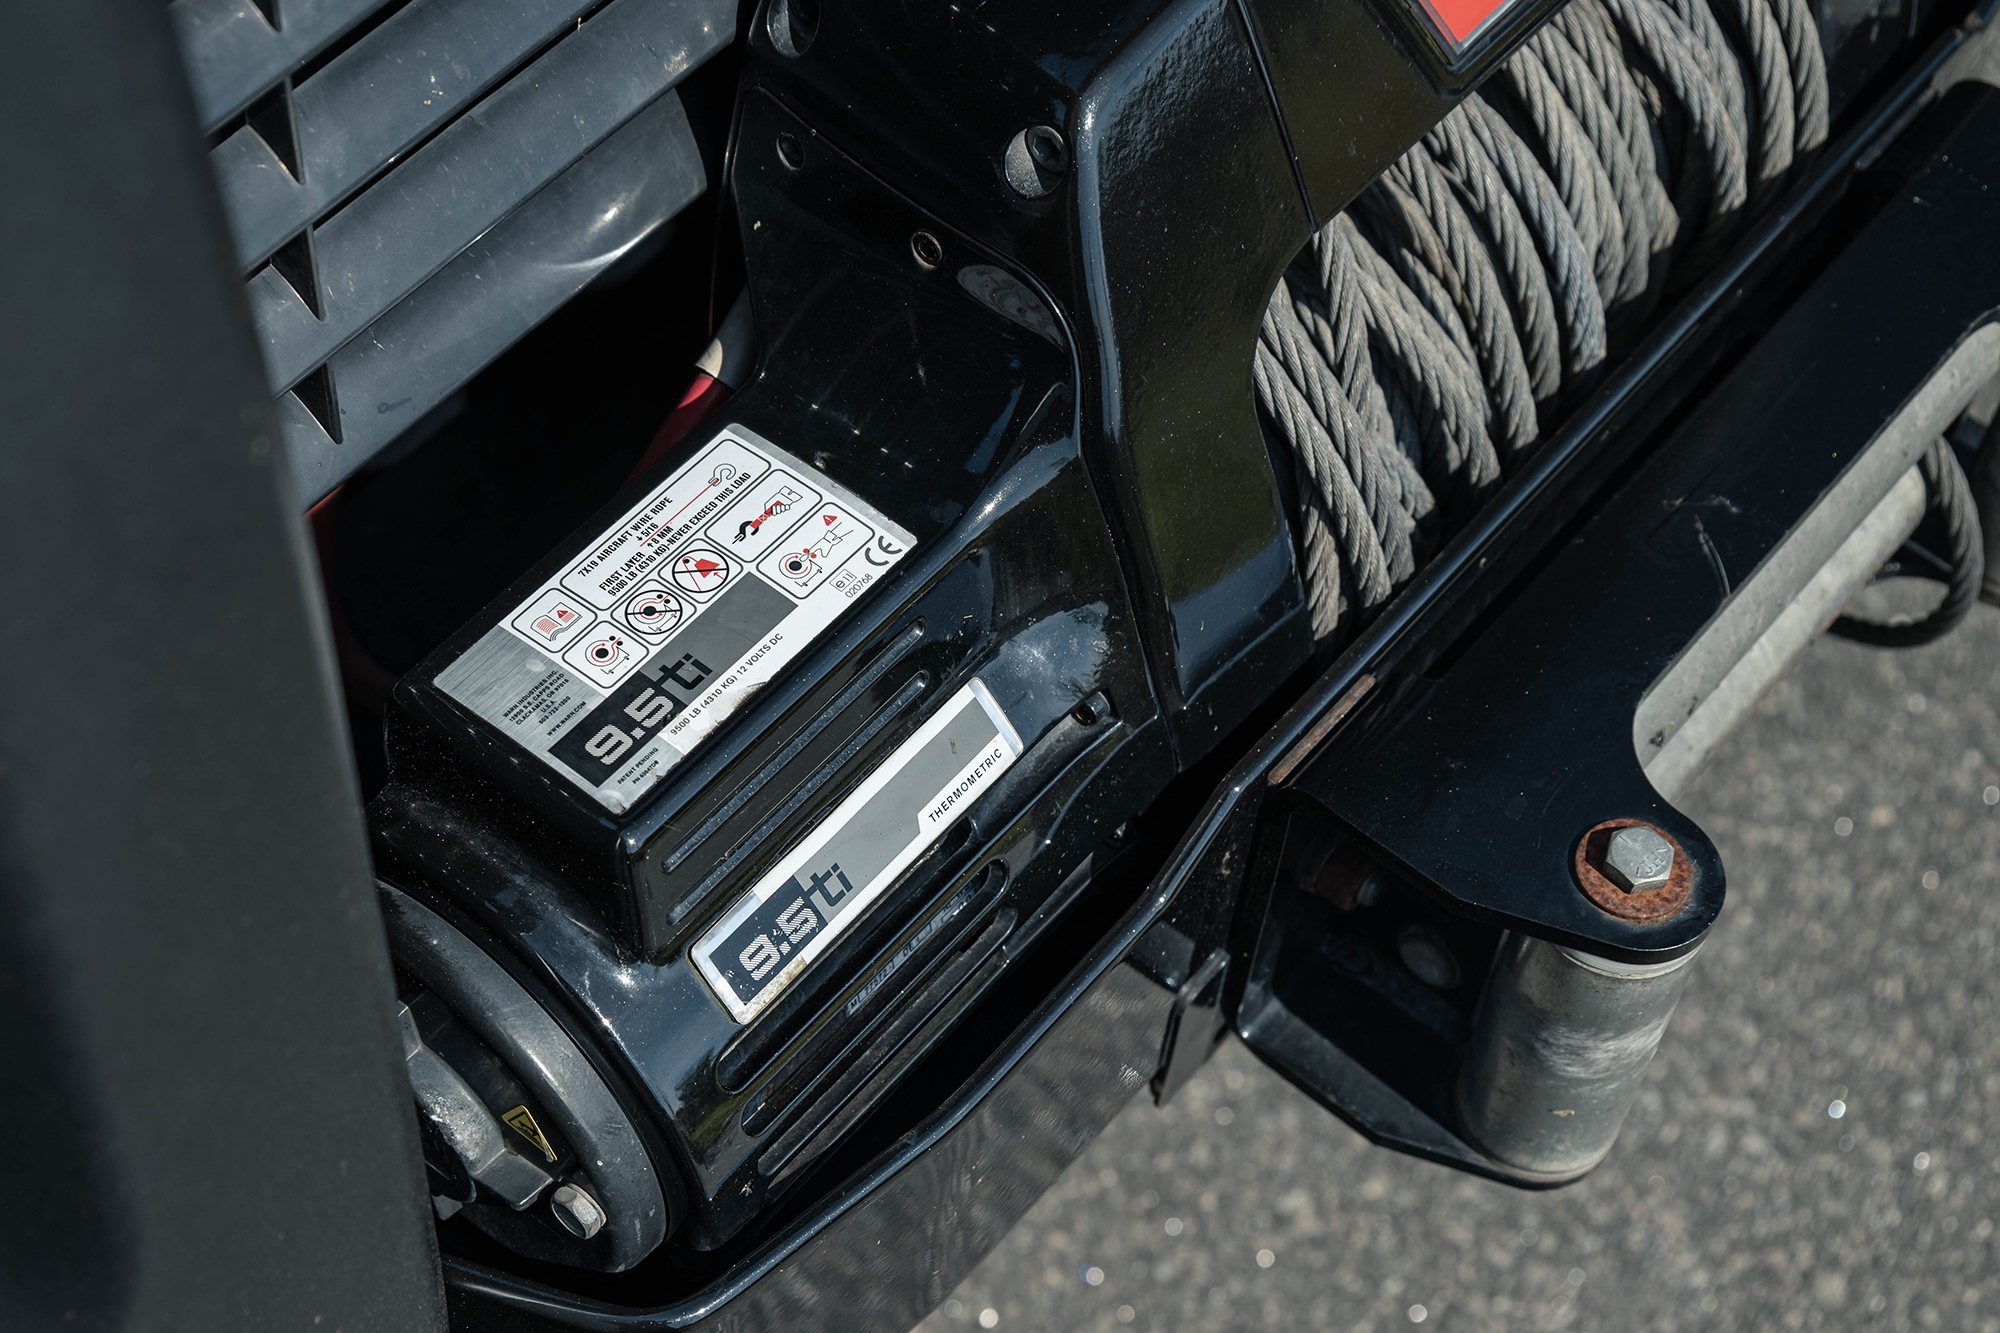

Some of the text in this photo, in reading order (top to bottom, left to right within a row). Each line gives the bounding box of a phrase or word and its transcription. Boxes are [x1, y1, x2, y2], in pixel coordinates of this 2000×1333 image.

[577, 495, 673, 577] 7X19 AIRCRAFT WIRE ROPE
[606, 578, 629, 596] 9500
[624, 570, 638, 581] LB
[633, 553, 658, 573] (4310
[687, 500, 718, 525] EXCEED
[714, 486, 734, 502] THIS
[729, 471, 751, 489] LOAD
[640, 521, 659, 537] 5/16
[650, 525, 674, 545] 8 MM
[598, 550, 645, 591] FIRST LAYER
[843, 572, 873, 598] 020768
[502, 703, 519, 718] WARN
[516, 678, 548, 705] INDUSTRIES
[531, 685, 550, 701] CAPPS
[548, 672, 565, 686] ROAD
[545, 690, 555, 698] OR
[669, 632, 783, 736] 9500 LB (4310 KG) 12 VOLTS DC
[546, 700, 587, 736] WWW.WARN.COM
[616, 746, 659, 784] PATENT PENDING
[927, 747, 1003, 823] THERMOMETRIC
